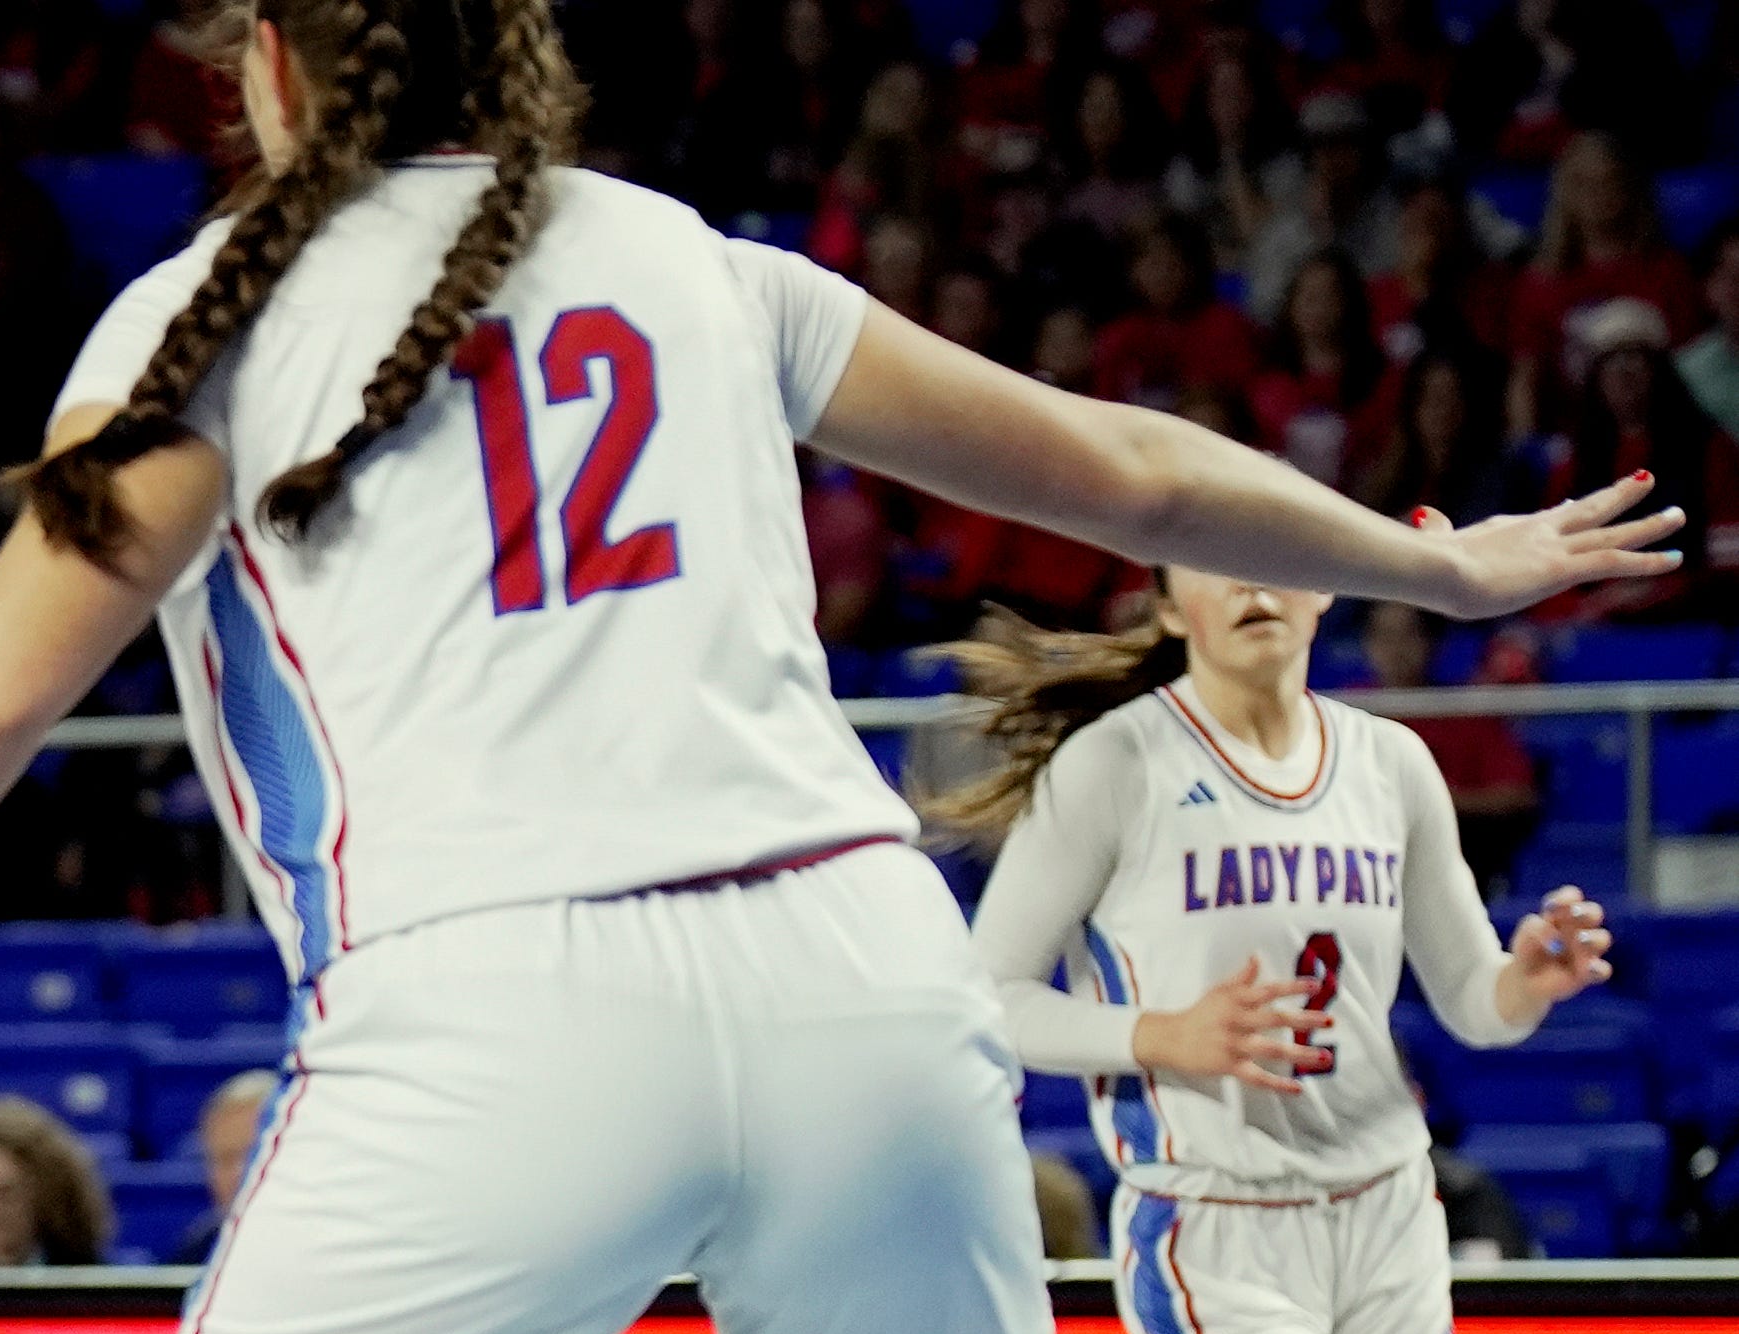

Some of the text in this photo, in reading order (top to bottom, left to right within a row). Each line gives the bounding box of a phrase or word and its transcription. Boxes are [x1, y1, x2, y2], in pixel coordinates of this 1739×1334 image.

[449, 305, 683, 616] 12
[1184, 845, 1397, 912] LADY PATS
[1294, 930, 1343, 1078] 2
